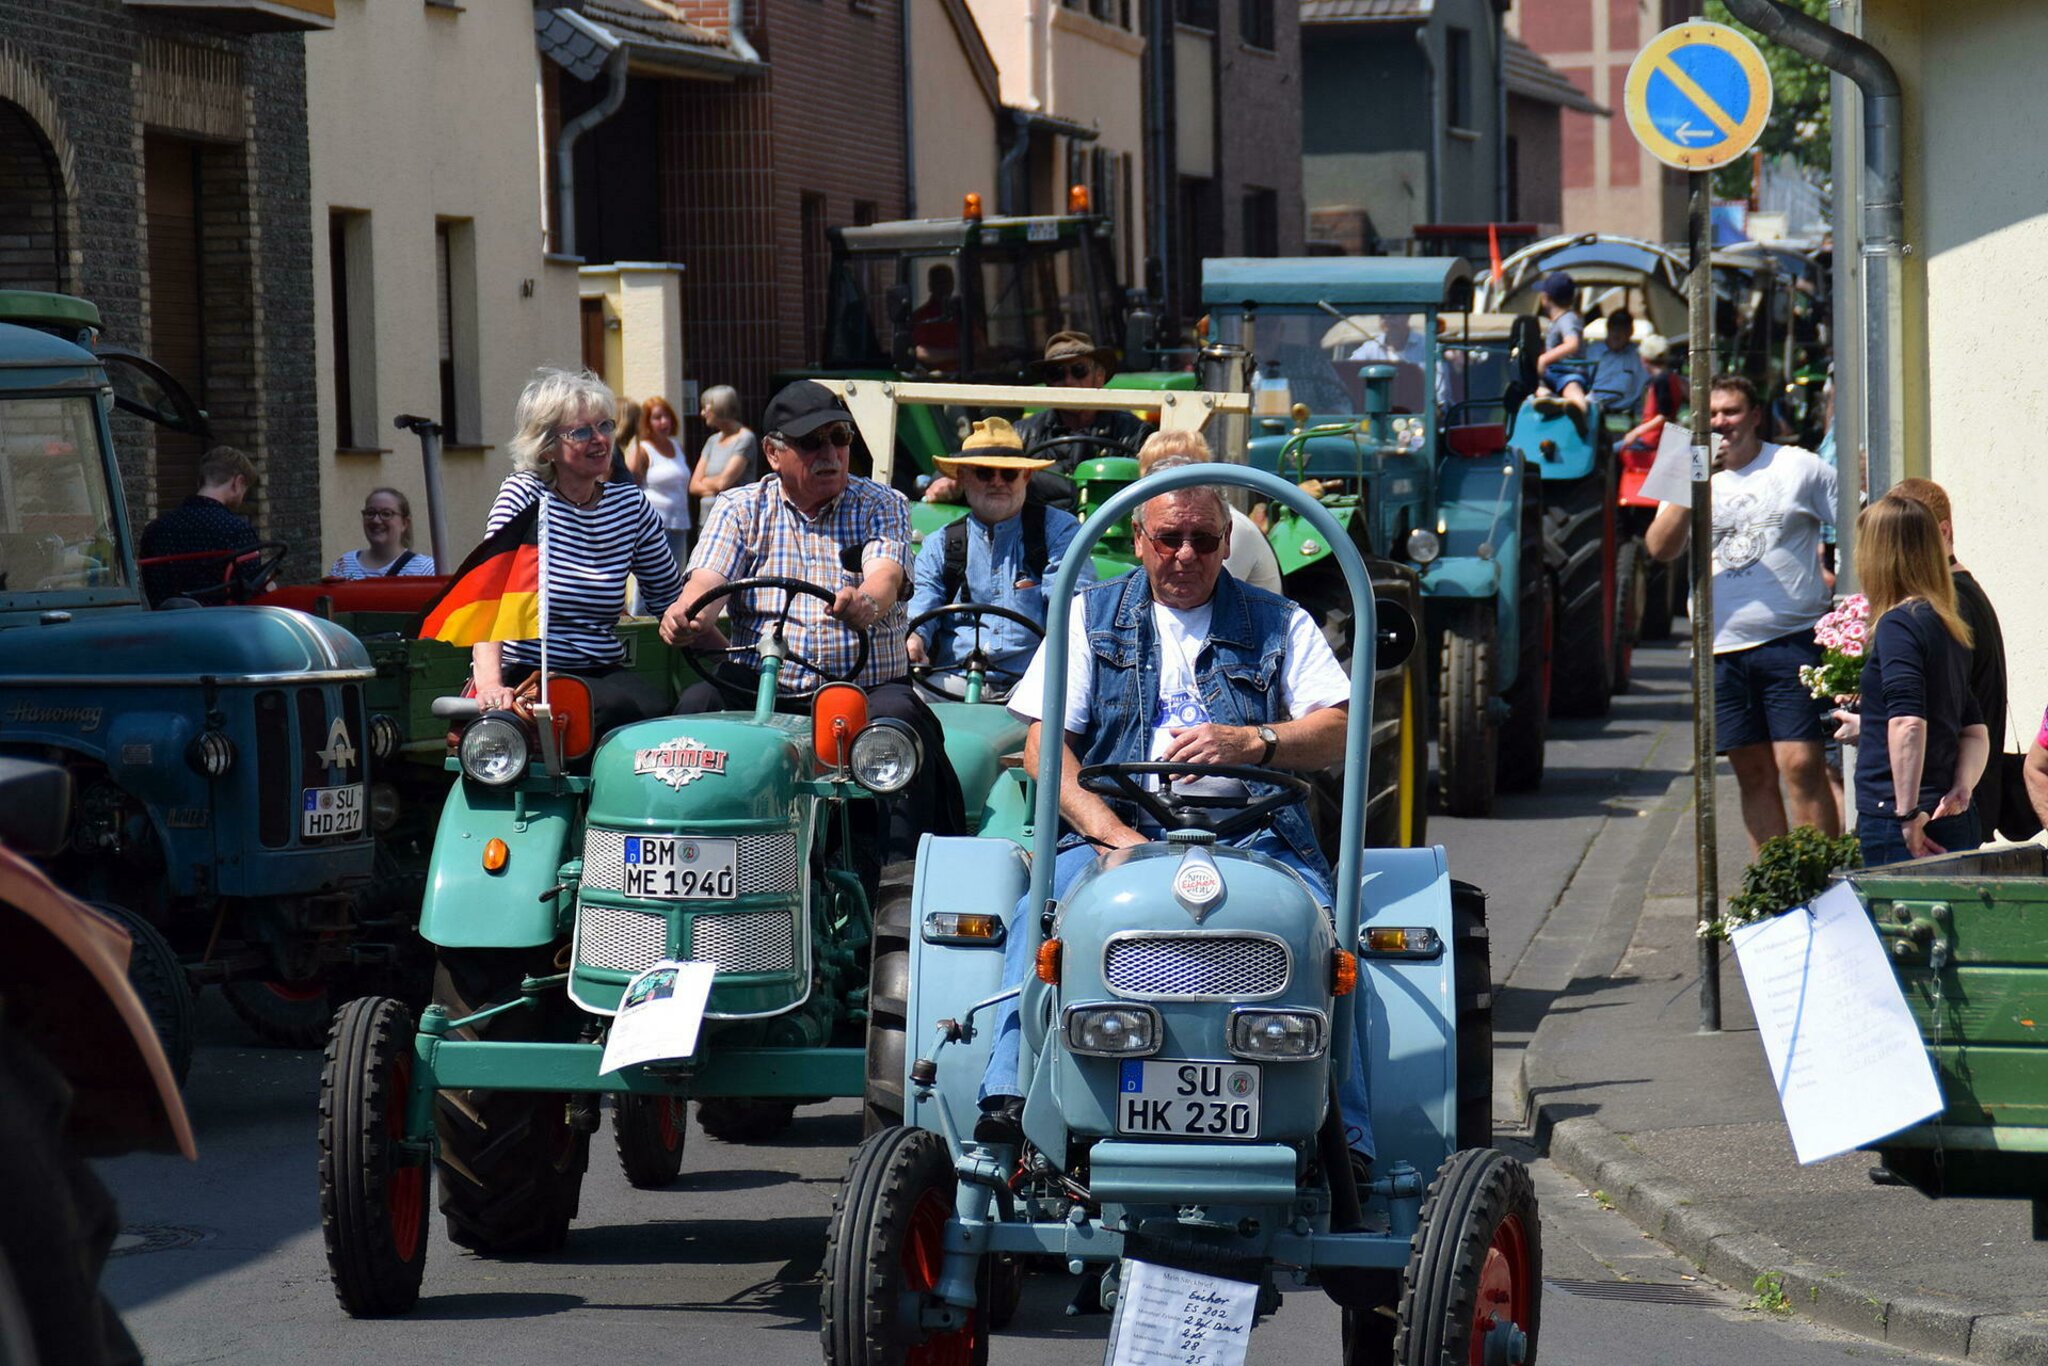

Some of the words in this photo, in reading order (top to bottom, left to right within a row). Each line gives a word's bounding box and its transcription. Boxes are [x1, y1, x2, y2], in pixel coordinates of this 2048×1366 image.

[5, 698, 103, 732] Hanomag
[635, 748, 728, 771] Kramer
[336, 789, 354, 810] SU
[310, 813, 334, 834] HD
[336, 809, 360, 832] 217
[630, 853, 637, 862] D
[643, 839, 675, 866] BM
[627, 868, 657, 894] ME
[664, 869, 733, 897] 1940
[1127, 1080, 1136, 1091] D
[1177, 1065, 1222, 1097] SU
[1127, 1099, 1173, 1131] HK
[1185, 1101, 1250, 1134] 230
[1184, 1302, 1199, 1313] ES
[1202, 1306, 1228, 1319] 202
[1185, 1354, 1207, 1365] 25
